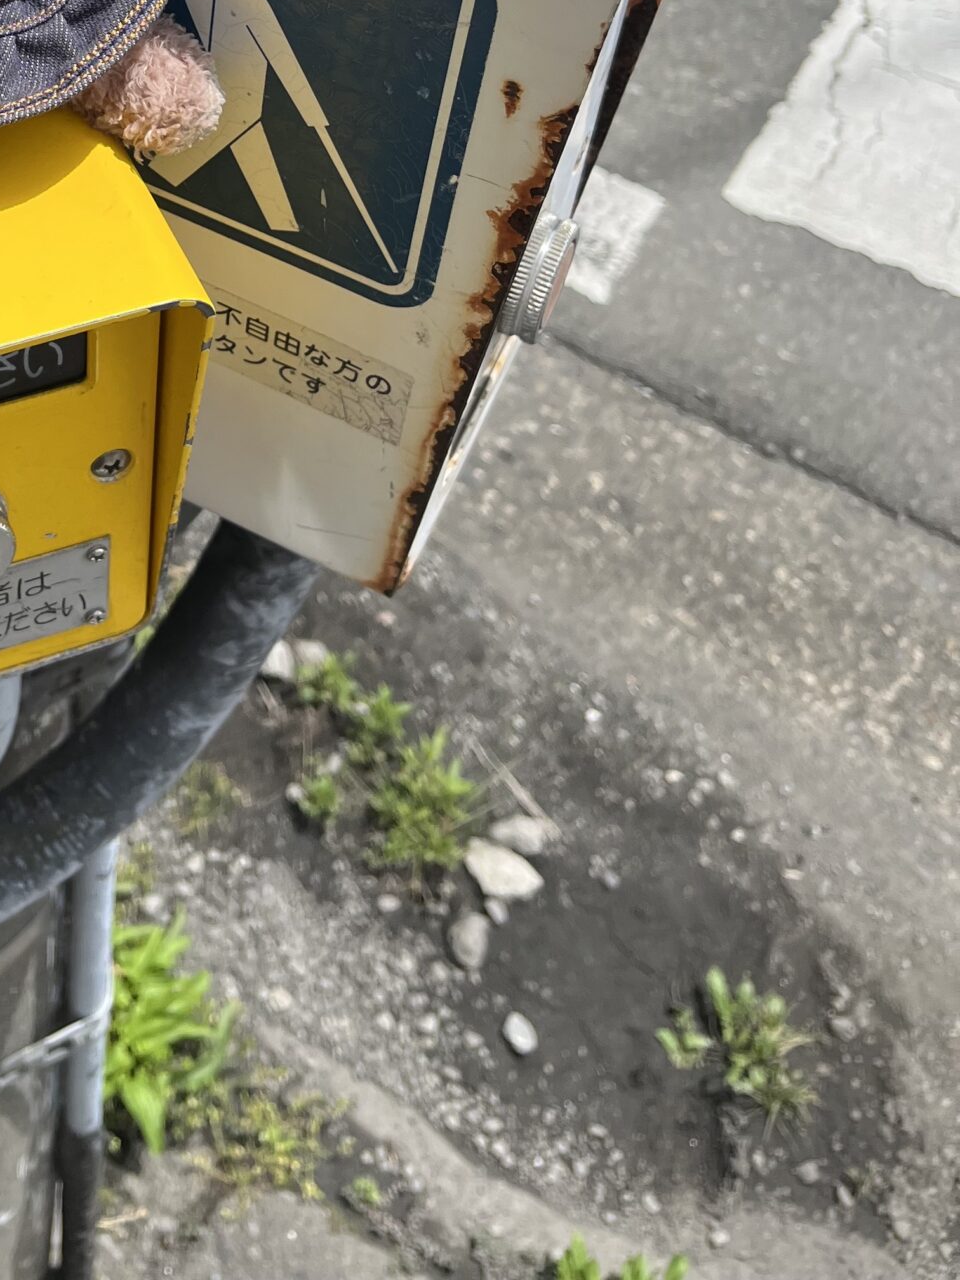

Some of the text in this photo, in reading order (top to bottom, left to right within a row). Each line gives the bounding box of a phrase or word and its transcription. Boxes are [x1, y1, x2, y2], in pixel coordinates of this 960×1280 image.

[215, 300, 392, 396] 不自由な方の
